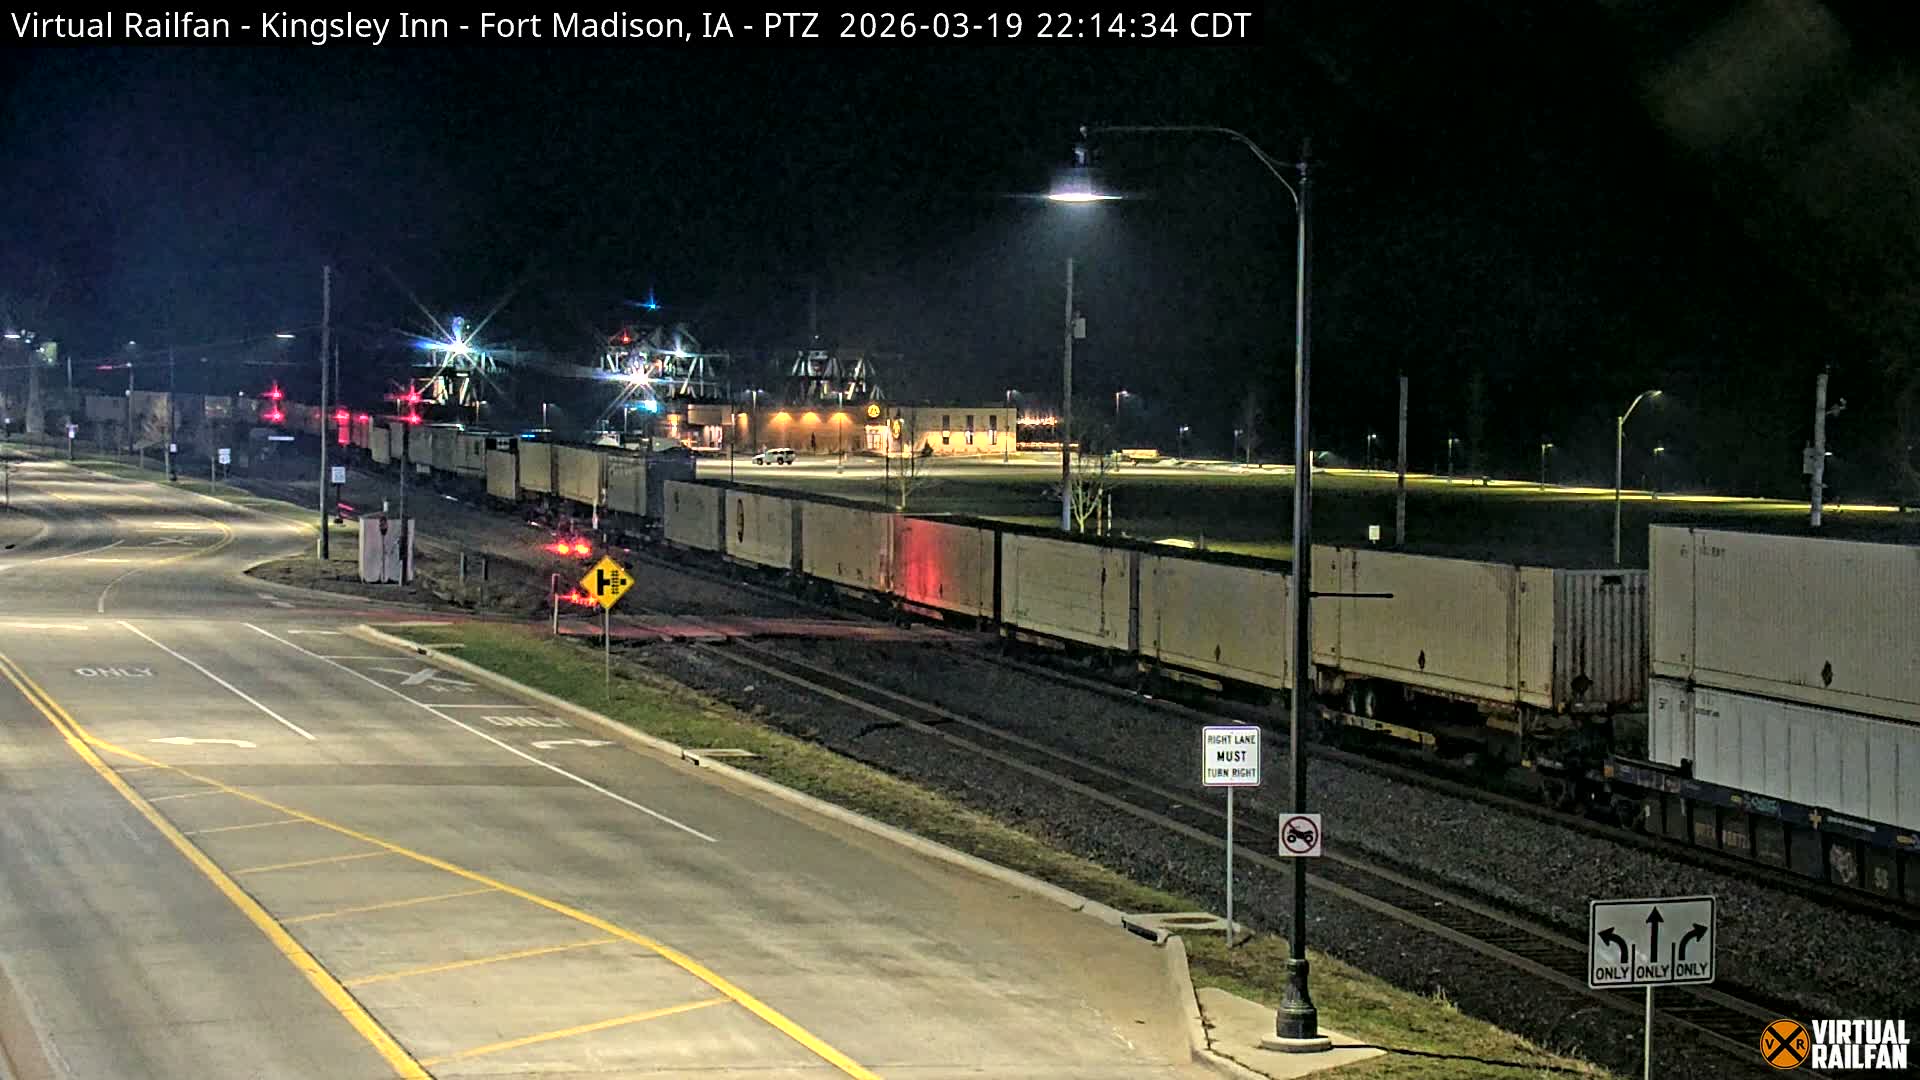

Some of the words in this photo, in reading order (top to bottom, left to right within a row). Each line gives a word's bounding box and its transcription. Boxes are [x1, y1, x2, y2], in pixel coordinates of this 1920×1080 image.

[74, 667, 153, 678] ONLY
[480, 715, 573, 728] ONLY
[1207, 734, 1231, 745] RIGHT
[1234, 734, 1256, 744] LANE
[1217, 751, 1247, 762] MUST
[1207, 768, 1229, 778] TURN
[1232, 767, 1256, 778] RIGHT
[1596, 967, 1630, 980] ONLY
[1636, 965, 1670, 978] ONLY
[1676, 963, 1709, 977] ONLY
